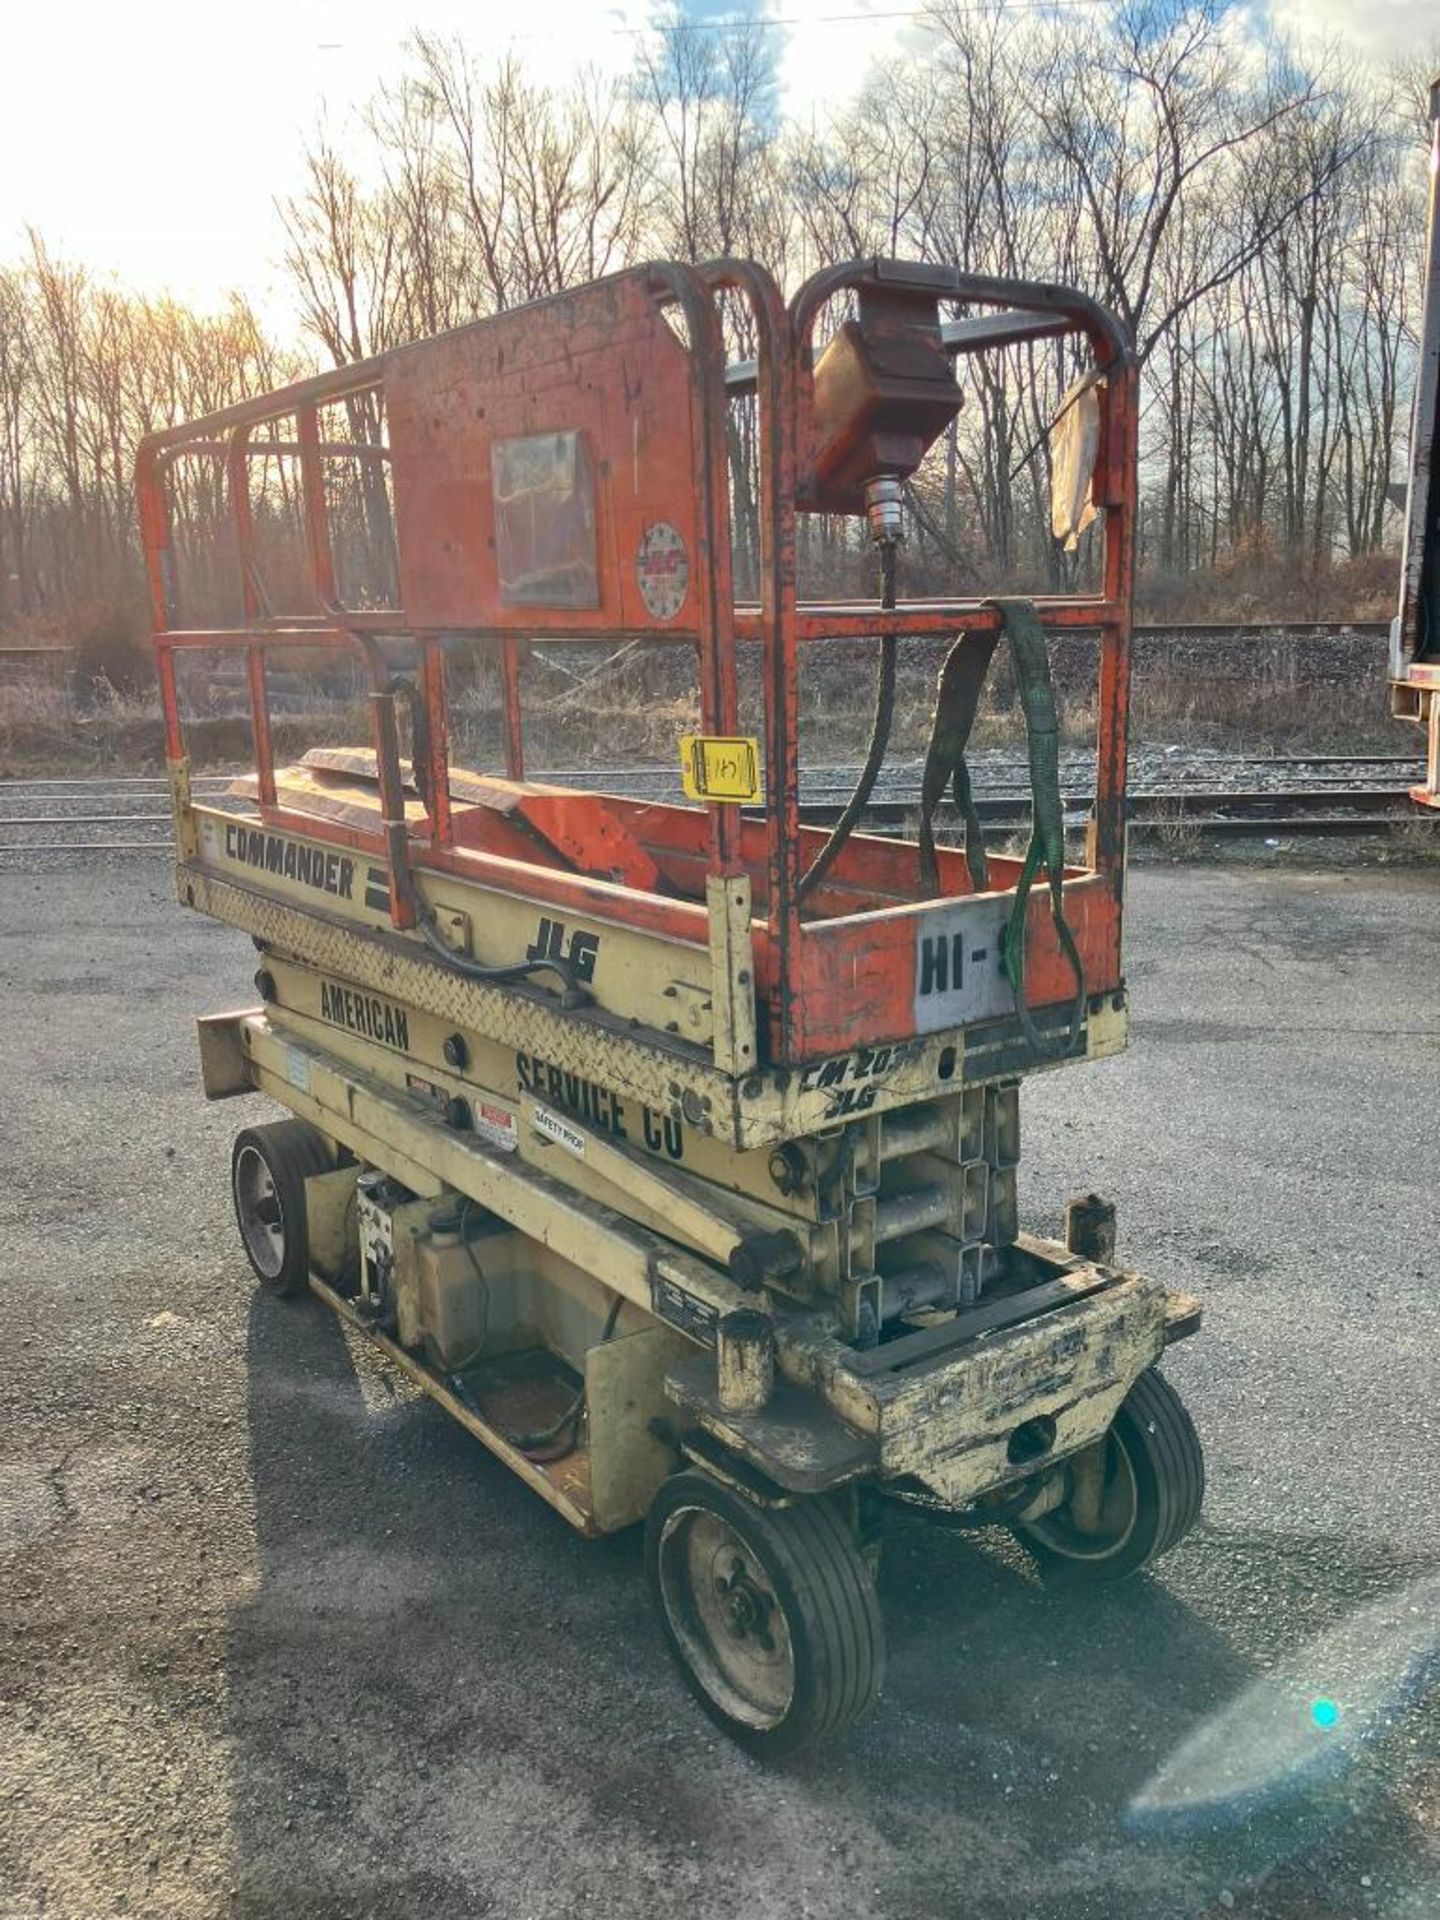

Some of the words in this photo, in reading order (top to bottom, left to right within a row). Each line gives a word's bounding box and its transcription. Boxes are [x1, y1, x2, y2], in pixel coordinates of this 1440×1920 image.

[225, 823, 355, 900] COMMANDER
[525, 916, 601, 984] JLG
[321, 980, 411, 1051] AMERICAN
[516, 1050, 629, 1140] SERVICE
[535, 1109, 563, 1136] SAFETY
[824, 1083, 877, 1119] JLG
